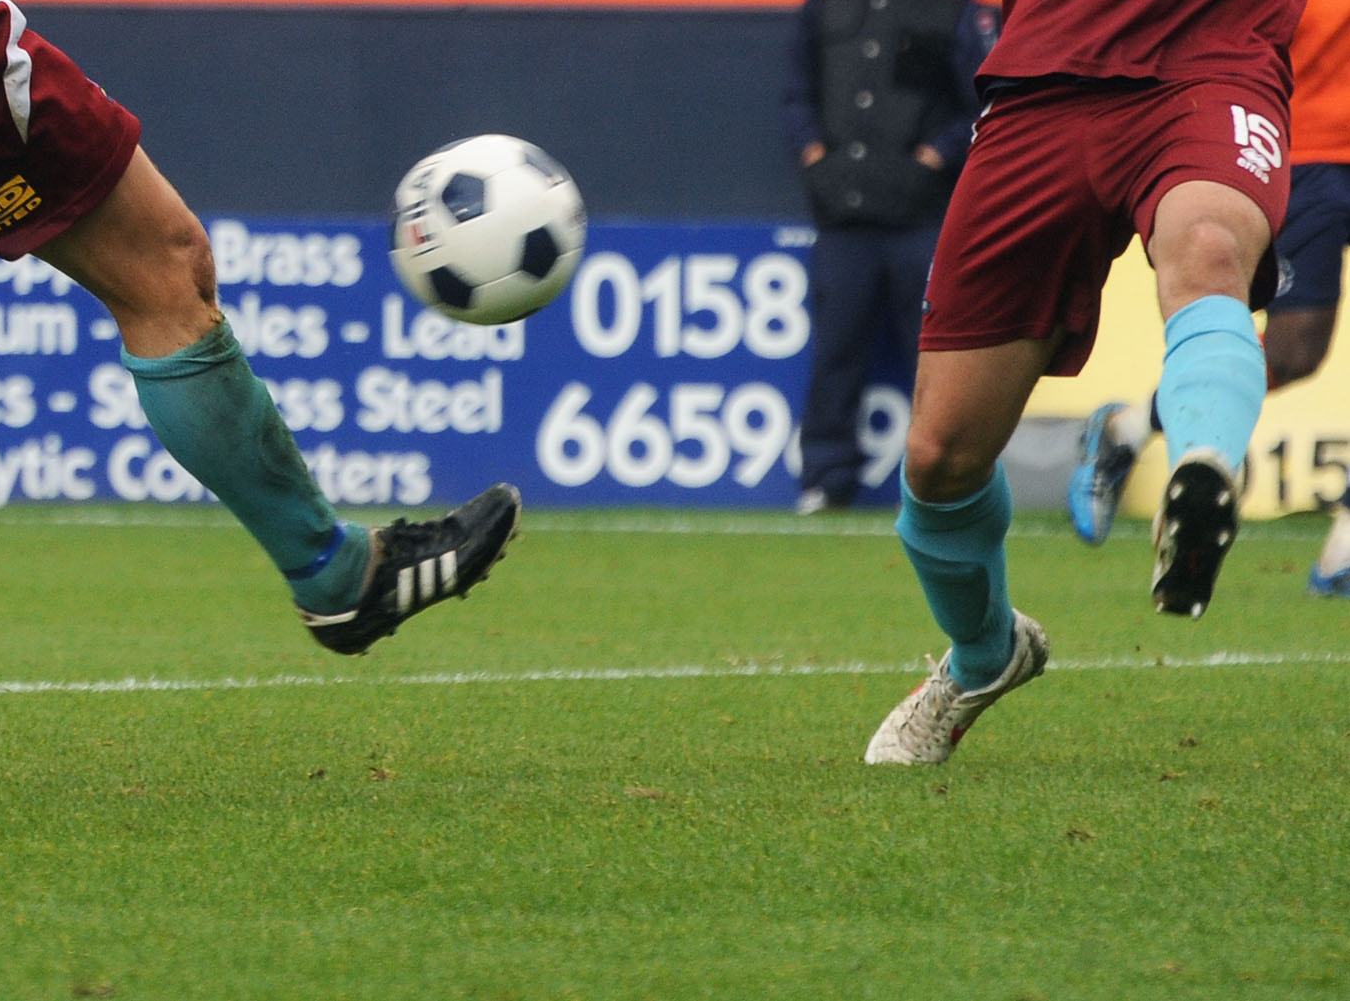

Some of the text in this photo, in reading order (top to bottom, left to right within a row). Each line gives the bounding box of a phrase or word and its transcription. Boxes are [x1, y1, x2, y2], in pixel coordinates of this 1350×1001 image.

[1230, 105, 1283, 169] 15
[210, 219, 364, 287] Brass
[382, 292, 526, 361] Lead
[356, 364, 503, 434] Steel
